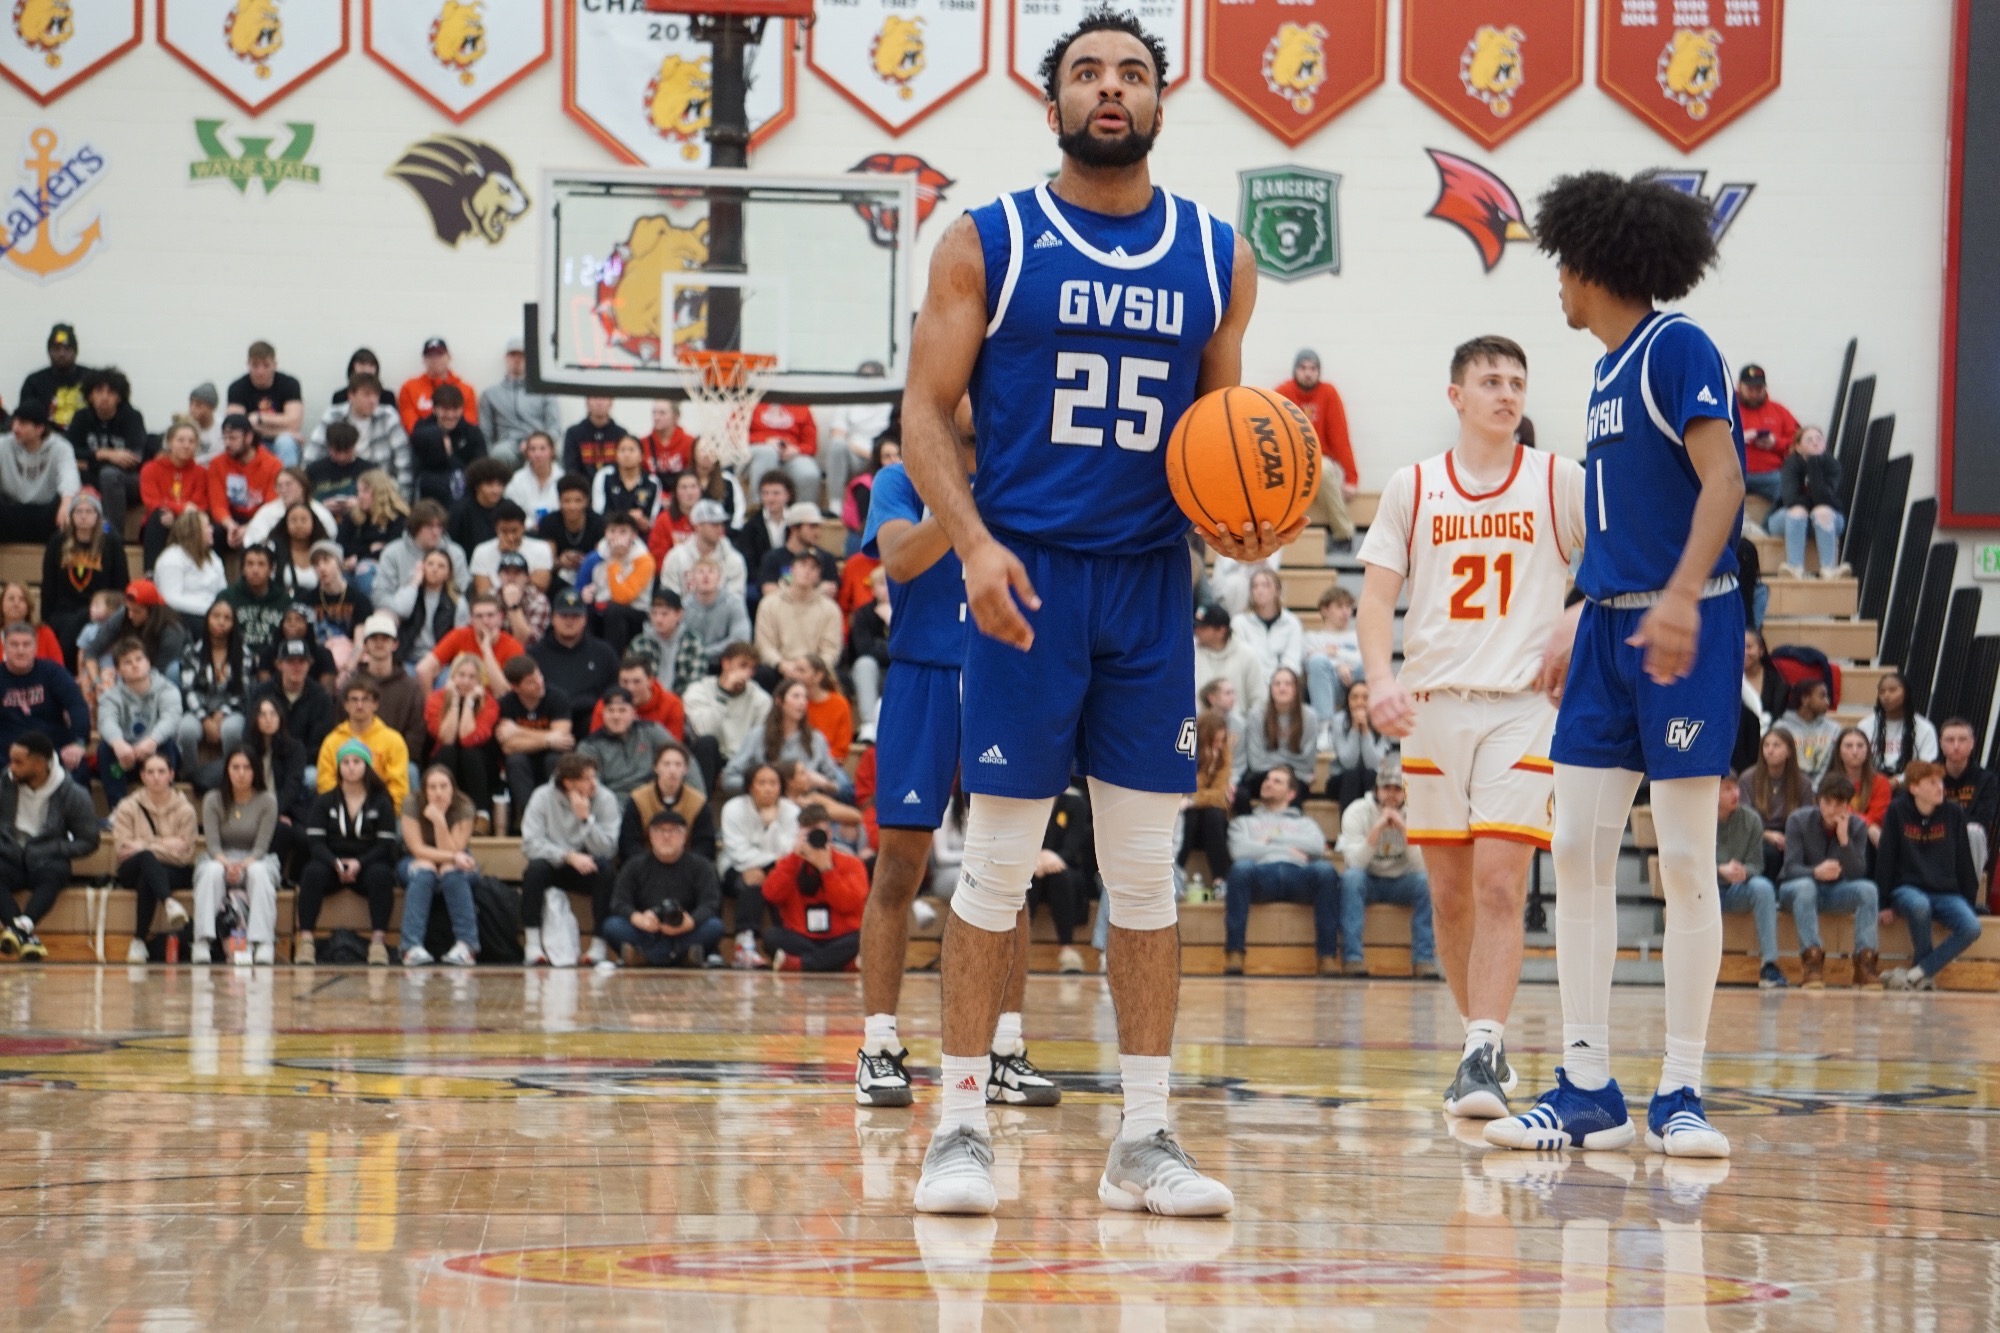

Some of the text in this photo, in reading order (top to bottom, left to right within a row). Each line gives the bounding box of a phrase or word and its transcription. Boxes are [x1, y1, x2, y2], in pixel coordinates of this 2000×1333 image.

[1251, 179, 1328, 203] RANGERS
[1058, 279, 1184, 337] GVSU
[1051, 351, 1170, 453] 25
[1250, 416, 1285, 490] NCAA
[1281, 399, 1319, 498] Wilson
[1596, 458, 1607, 532] 1
[1431, 511, 1536, 547] BULLDOGS
[1450, 552, 1514, 621] 21
[979, 756, 1008, 765] adidas
[1665, 717, 1705, 752] GV
